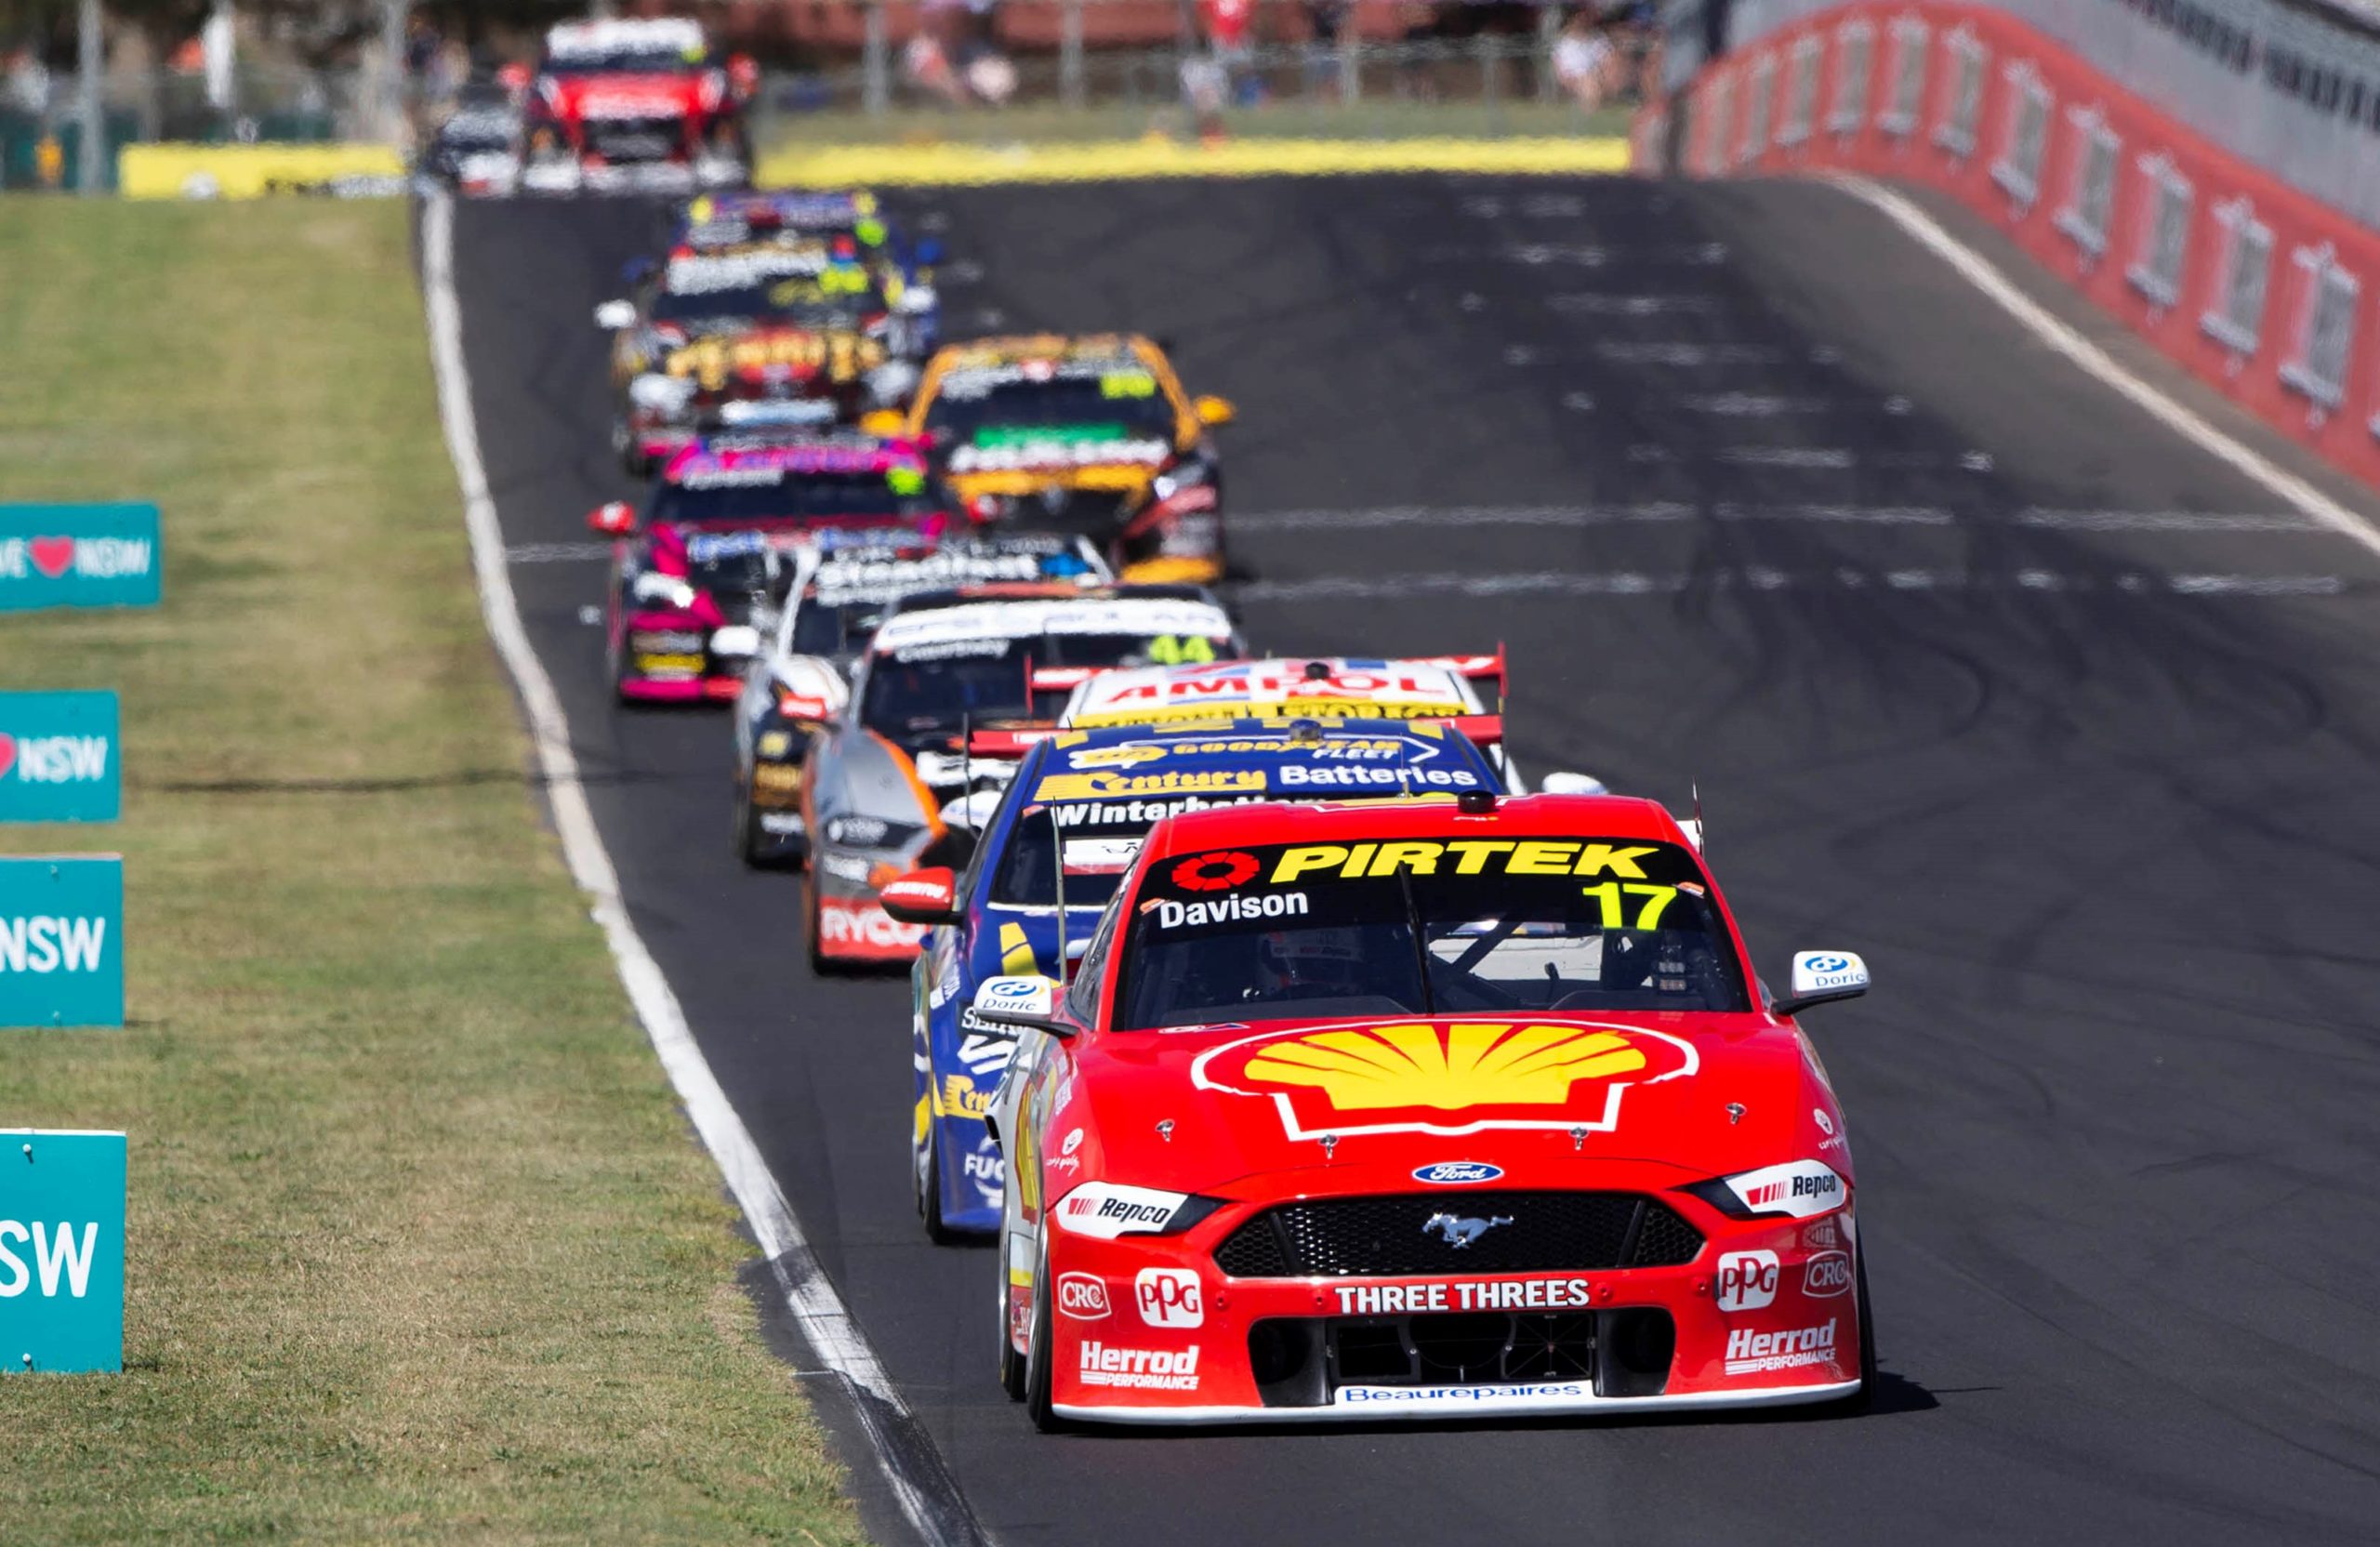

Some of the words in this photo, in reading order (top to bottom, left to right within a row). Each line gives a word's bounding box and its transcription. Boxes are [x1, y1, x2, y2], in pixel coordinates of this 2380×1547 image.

[1149, 635, 1215, 666] 44
[1104, 674, 1447, 704] AMPOL
[18, 735, 108, 783] NSW
[1312, 747, 1398, 760] FLEET
[1077, 771, 1266, 793] Century
[1279, 765, 1477, 787] Batteries
[1270, 840, 1660, 882] PIRTEK
[1160, 892, 1309, 929] Davison
[1582, 881, 1677, 931] 17
[0, 915, 106, 973] NSW
[1816, 973, 1867, 987] Doric
[984, 998, 1038, 1012] Doric
[1430, 1164, 1488, 1181] Ford
[1792, 1175, 1836, 1198] Repco
[1098, 1197, 1171, 1224] Repco
[1720, 1257, 1777, 1304] PPG
[1809, 1260, 1846, 1287] CRC
[1062, 1281, 1104, 1309] CRC
[1139, 1274, 1199, 1321] PPG
[1335, 1284, 1450, 1315] THREE
[1454, 1279, 1590, 1310] THREES
[1726, 1317, 1837, 1359] Herrod
[1080, 1340, 1200, 1374] Herrod
[1757, 1348, 1837, 1371] PERFORMANCE
[1105, 1372, 1199, 1391] PERFORMANCE
[1345, 1383, 1582, 1403] Beaurepaires
